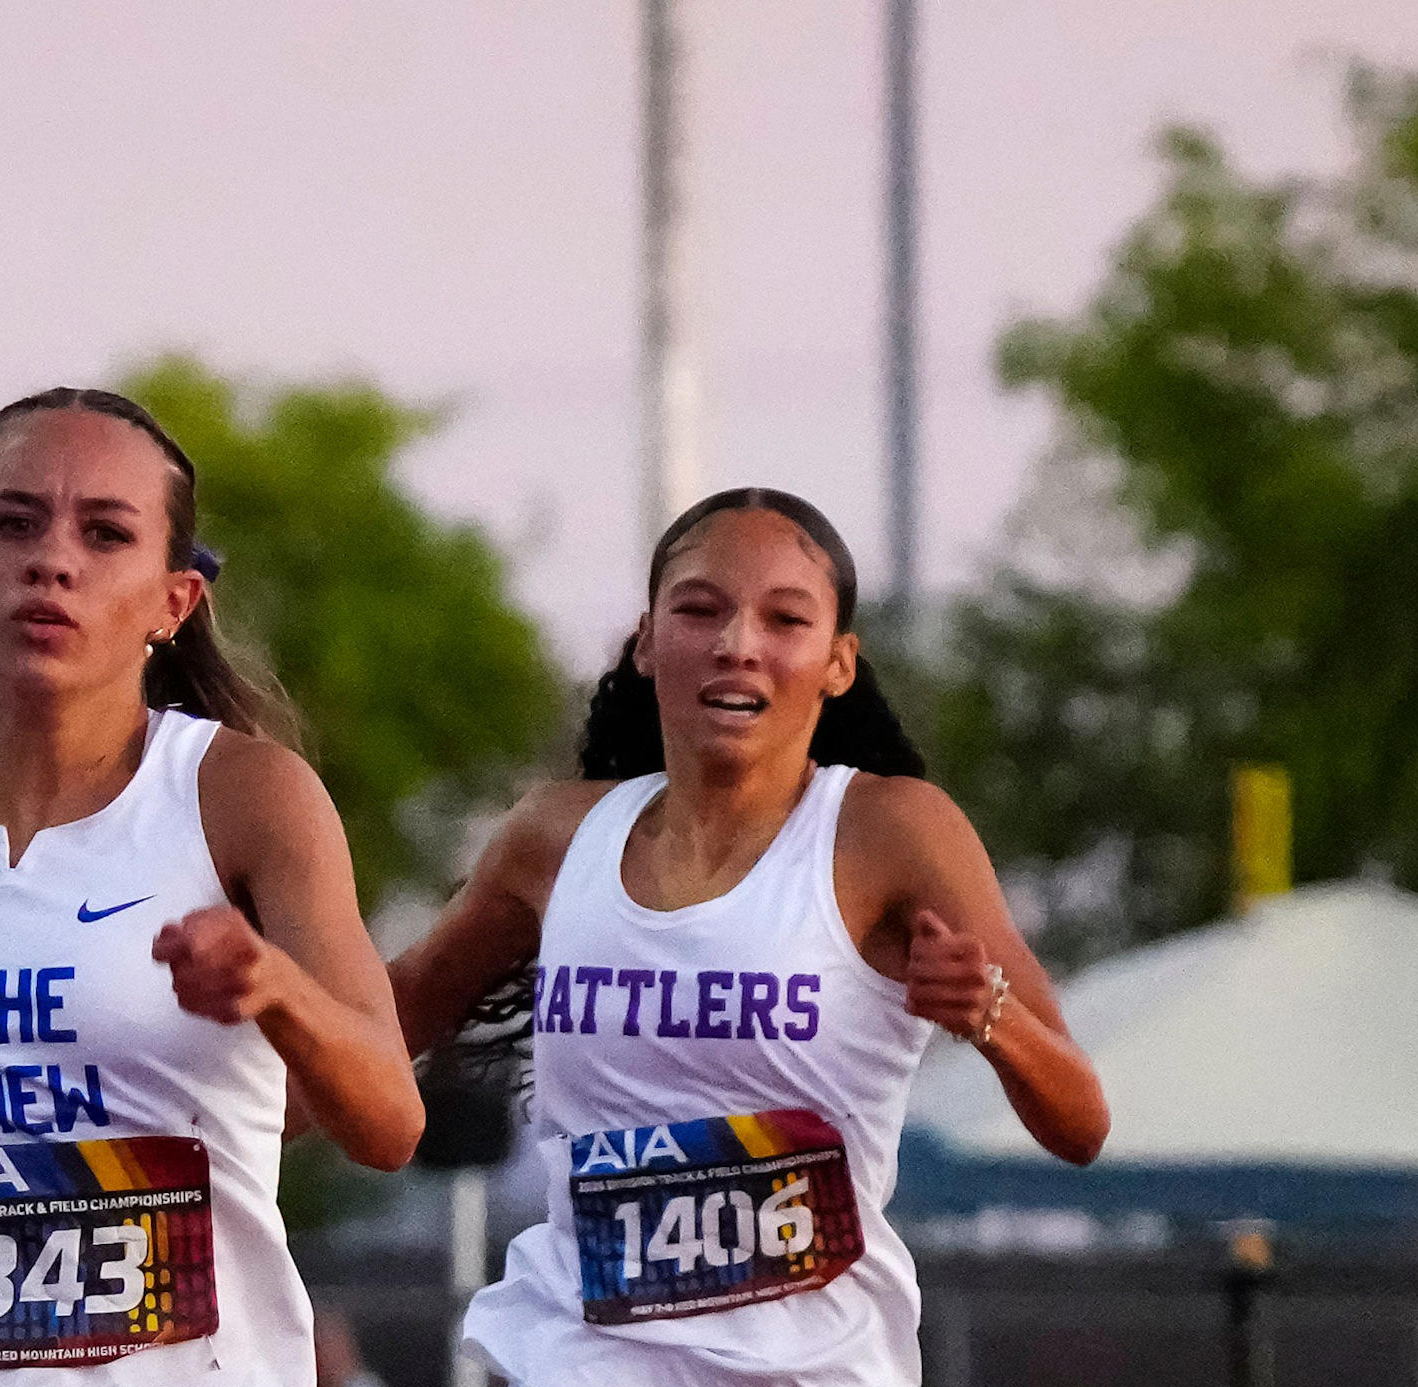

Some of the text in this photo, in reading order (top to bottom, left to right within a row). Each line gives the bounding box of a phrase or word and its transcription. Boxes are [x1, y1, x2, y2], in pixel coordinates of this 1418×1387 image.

[580, 1124, 688, 1173] AIA
[36, 1202, 48, 1215] &
[49, 1200, 88, 1213] FIELD
[90, 1189, 203, 1210] CHAMPIONSHIPS
[614, 1176, 814, 1279] 1406
[20, 1348, 85, 1360] MOUNTAIN
[87, 1345, 118, 1358] HIGH
